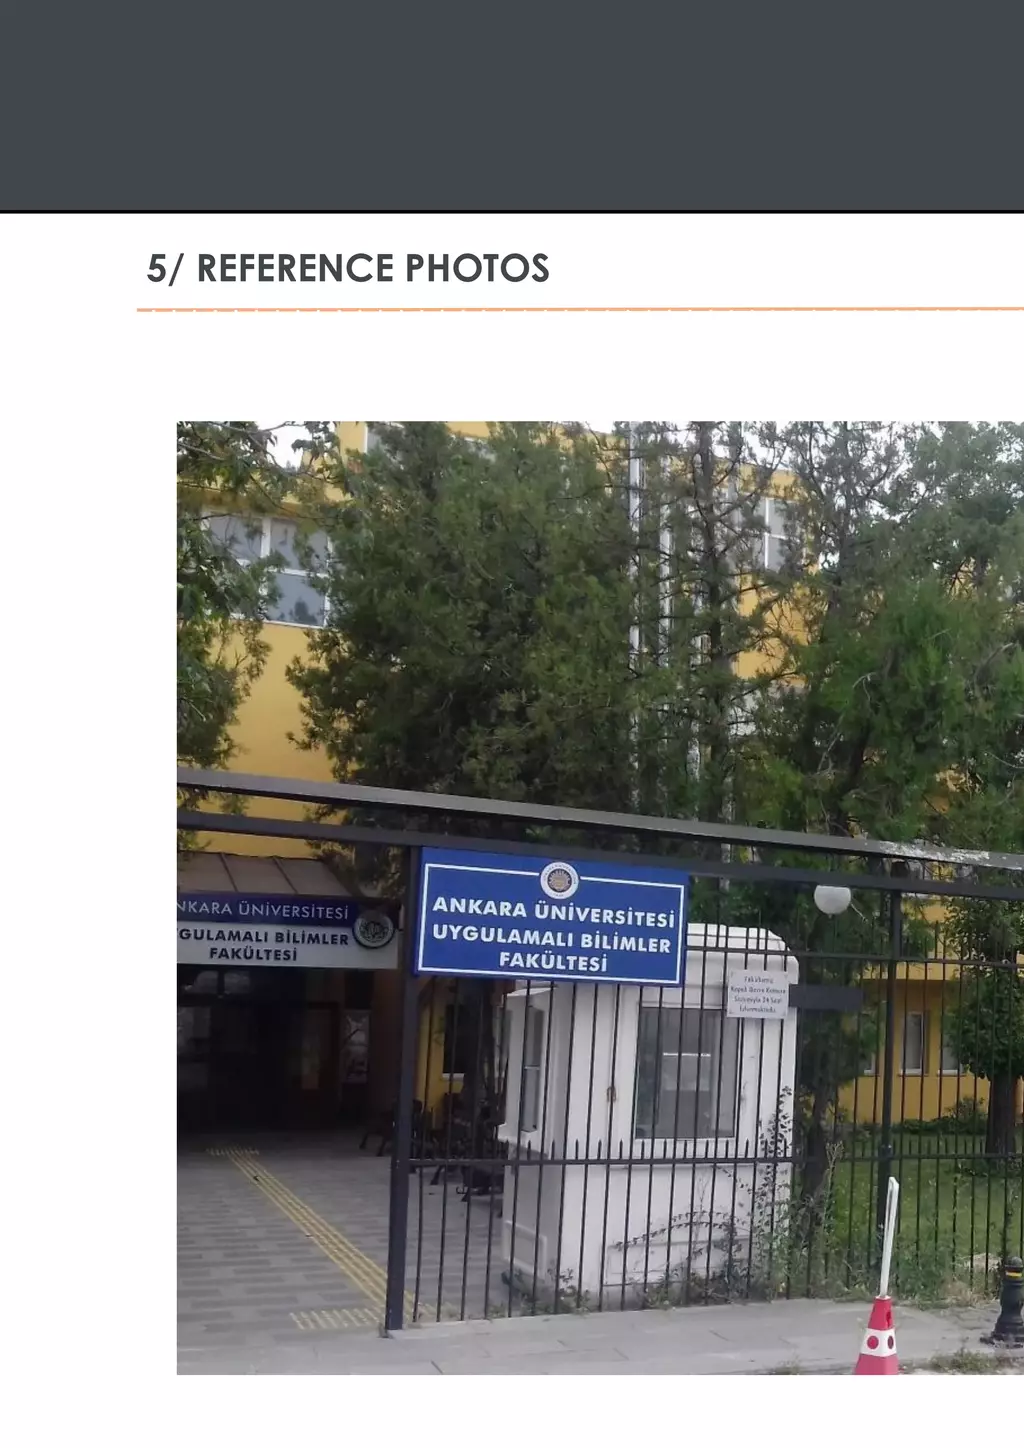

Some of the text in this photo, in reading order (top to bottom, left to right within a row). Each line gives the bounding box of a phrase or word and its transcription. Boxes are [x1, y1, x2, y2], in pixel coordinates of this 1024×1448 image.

[147, 253, 550, 287] 5/ REFERENCE PHOTOS
[239, 900, 349, 920] ÜNİVERSİTESİ
[432, 896, 675, 929] ANKARA ÜNİVERSİTESİ
[177, 928, 349, 946] GULAMALI BİLİMLER
[433, 923, 671, 954] UYGULAMALI BİLİMLER
[209, 945, 297, 961] FAKÜLTESİ
[499, 949, 608, 972] FAKÜLTESİ
